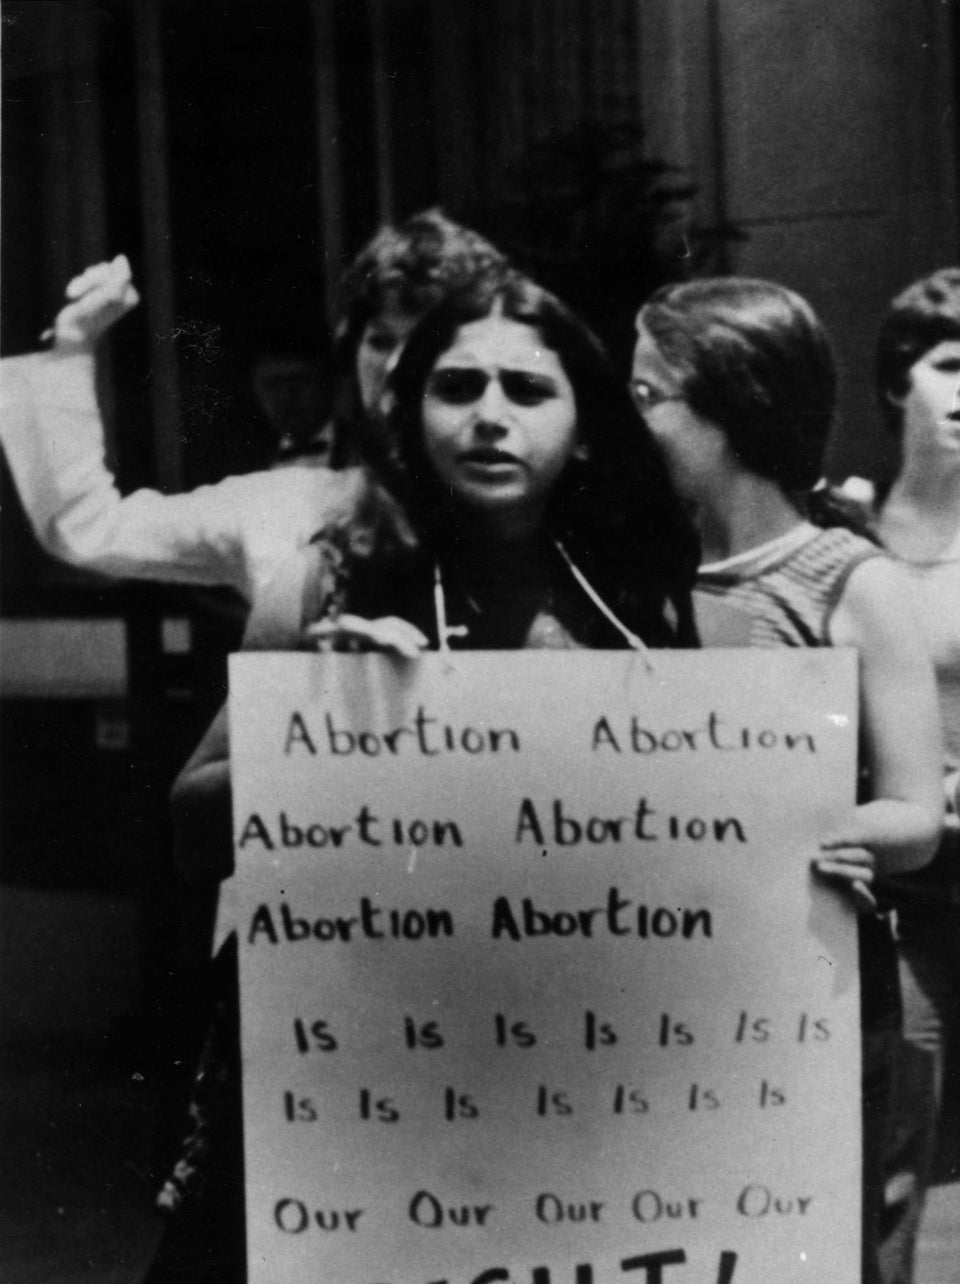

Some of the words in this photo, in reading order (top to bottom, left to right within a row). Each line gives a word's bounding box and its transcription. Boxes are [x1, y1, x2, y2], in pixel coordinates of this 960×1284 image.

[283, 705, 521, 758] Abortion
[591, 710, 817, 755] Abortion
[240, 804, 464, 851] Abortion
[515, 796, 749, 847] Abortion
[248, 896, 454, 946] Abortion
[491, 886, 713, 942] Abortion
[293, 1017, 339, 1056] Is
[404, 1016, 444, 1050] Is
[494, 1013, 537, 1049] Is
[584, 1010, 618, 1052] Is
[658, 1012, 695, 1048] Is
[734, 1010, 770, 1044] Is
[797, 1012, 830, 1044] Is
[283, 1090, 318, 1124] Is
[359, 1088, 401, 1124] Is
[444, 1086, 480, 1122] Is
[536, 1084, 574, 1117] Is
[613, 1084, 649, 1115] Is
[688, 1082, 720, 1112] Is
[758, 1079, 787, 1109] Is
[273, 1197, 365, 1235] Our
[407, 1189, 495, 1230] Our
[534, 1192, 605, 1224] Our
[631, 1190, 703, 1223] Our
[736, 1184, 812, 1217] Our
